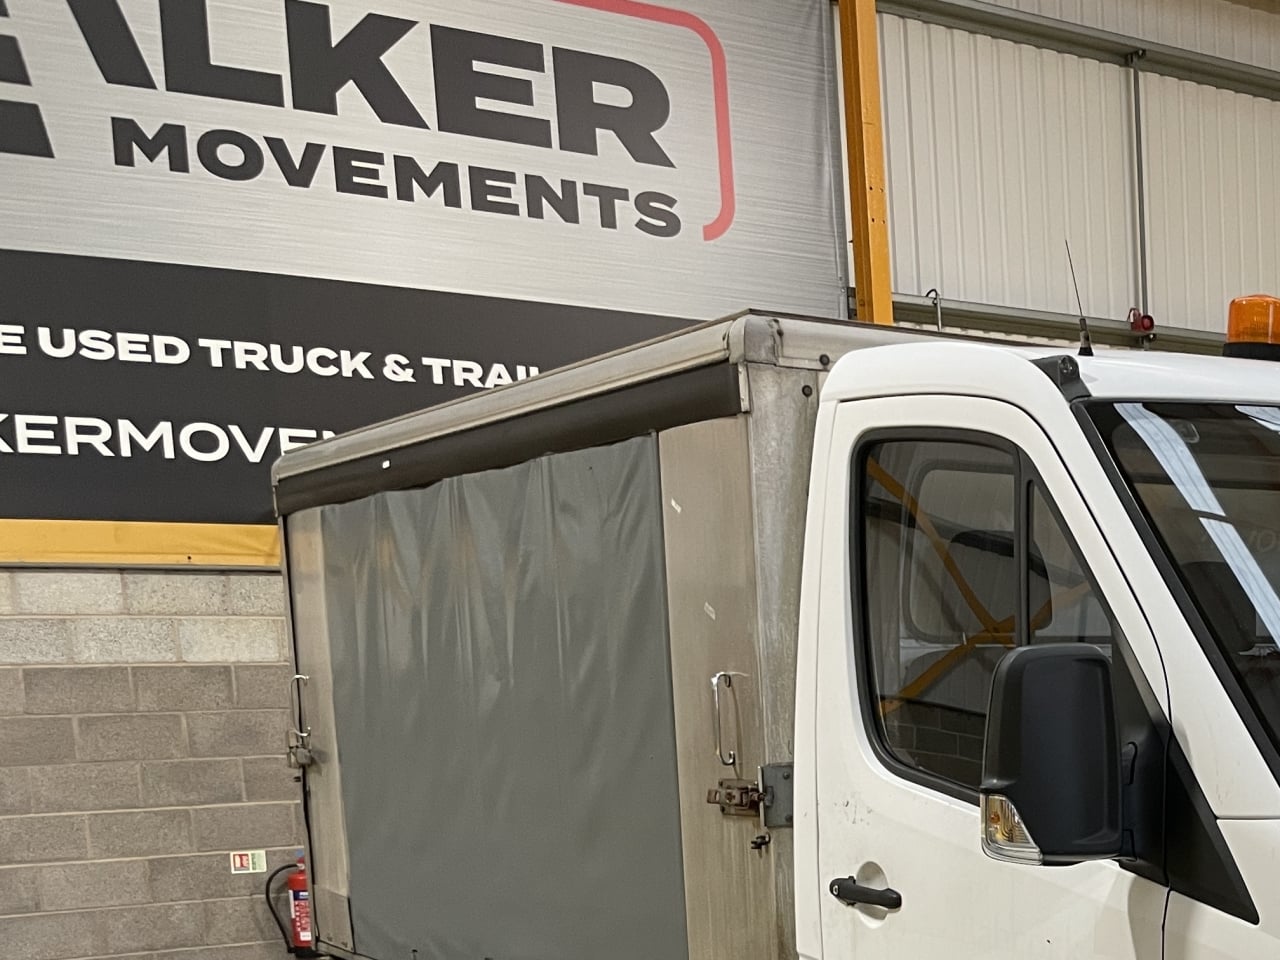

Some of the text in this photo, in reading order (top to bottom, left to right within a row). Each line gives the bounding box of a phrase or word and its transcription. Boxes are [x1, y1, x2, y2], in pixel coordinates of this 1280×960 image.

[111, 116, 682, 238] MOVEMENTS
[37, 326, 191, 365] USED
[198, 338, 375, 379] TRUCK
[383, 353, 417, 383] &
